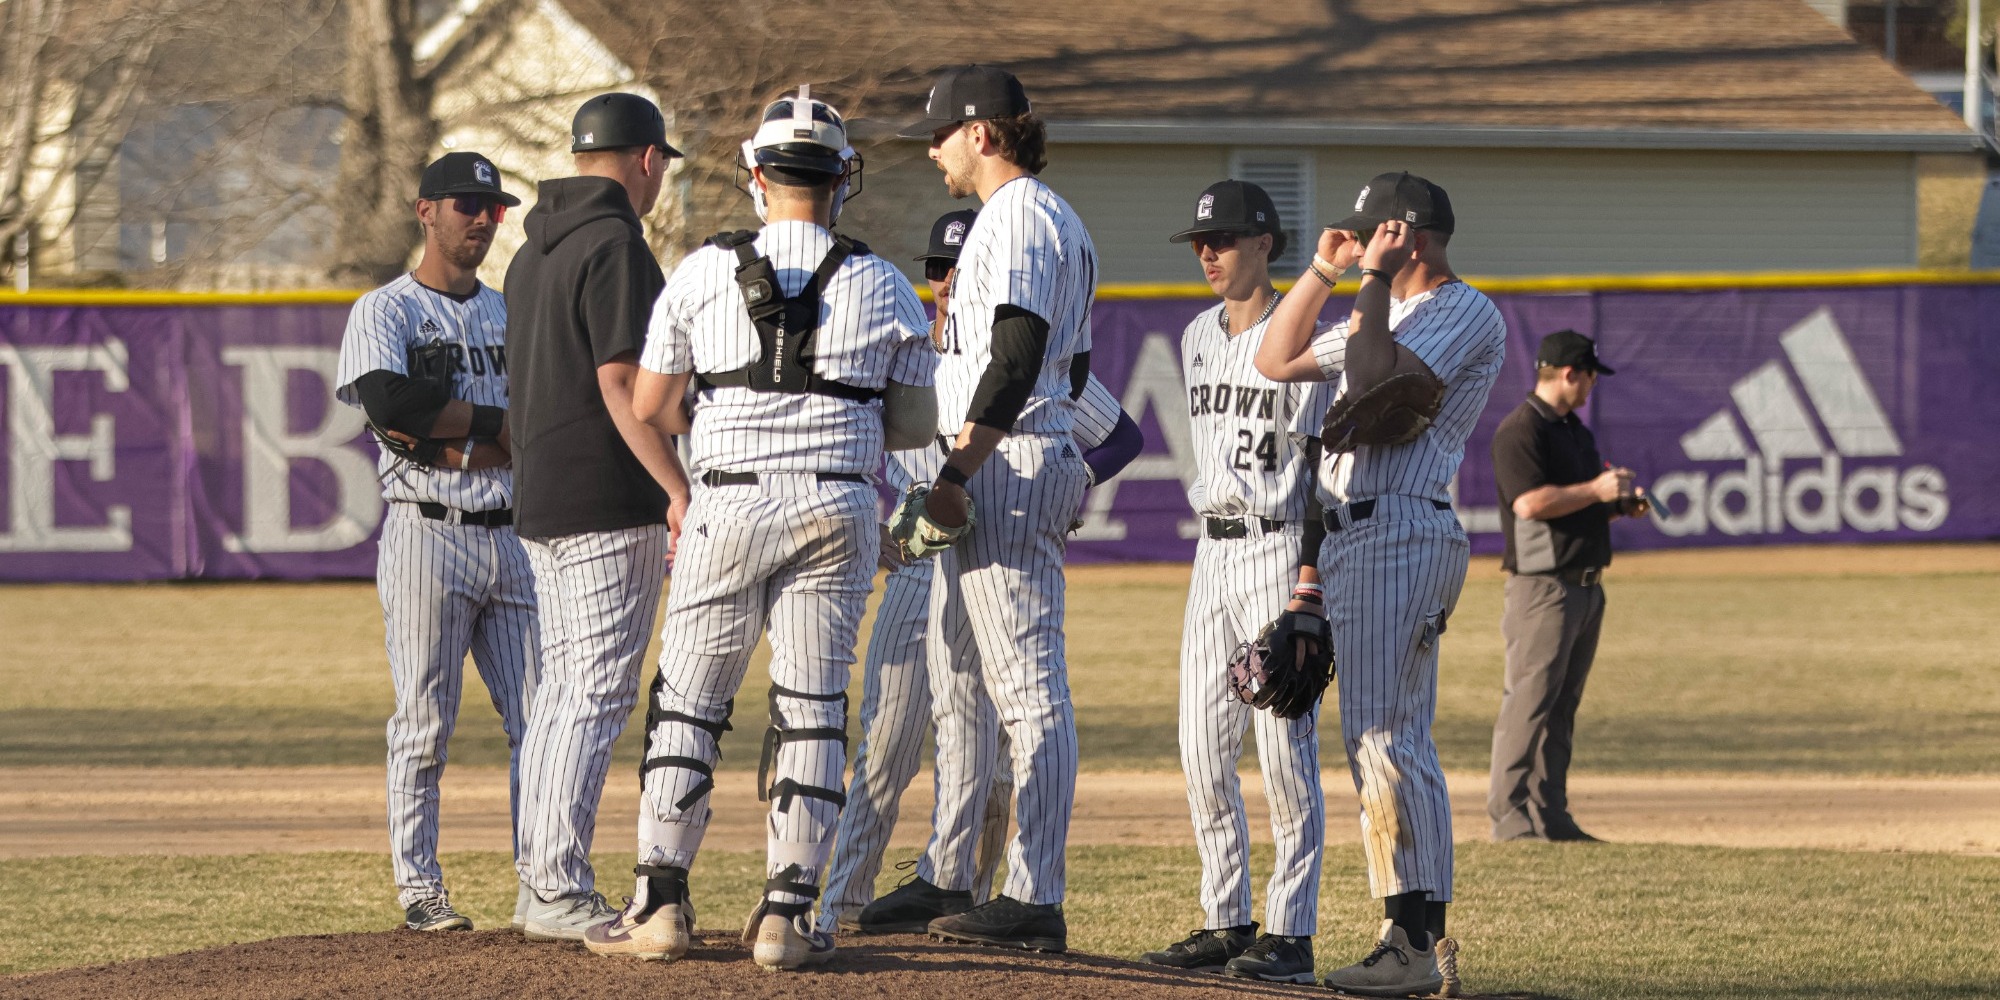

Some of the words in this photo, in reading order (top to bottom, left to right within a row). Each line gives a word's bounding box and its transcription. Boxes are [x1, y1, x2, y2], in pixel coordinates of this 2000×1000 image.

[773, 312, 786, 383] EVOSHIELD
[1190, 383, 1277, 420] CROWN
[1234, 428, 1277, 472] 24
[1650, 452, 1949, 537] adidas
